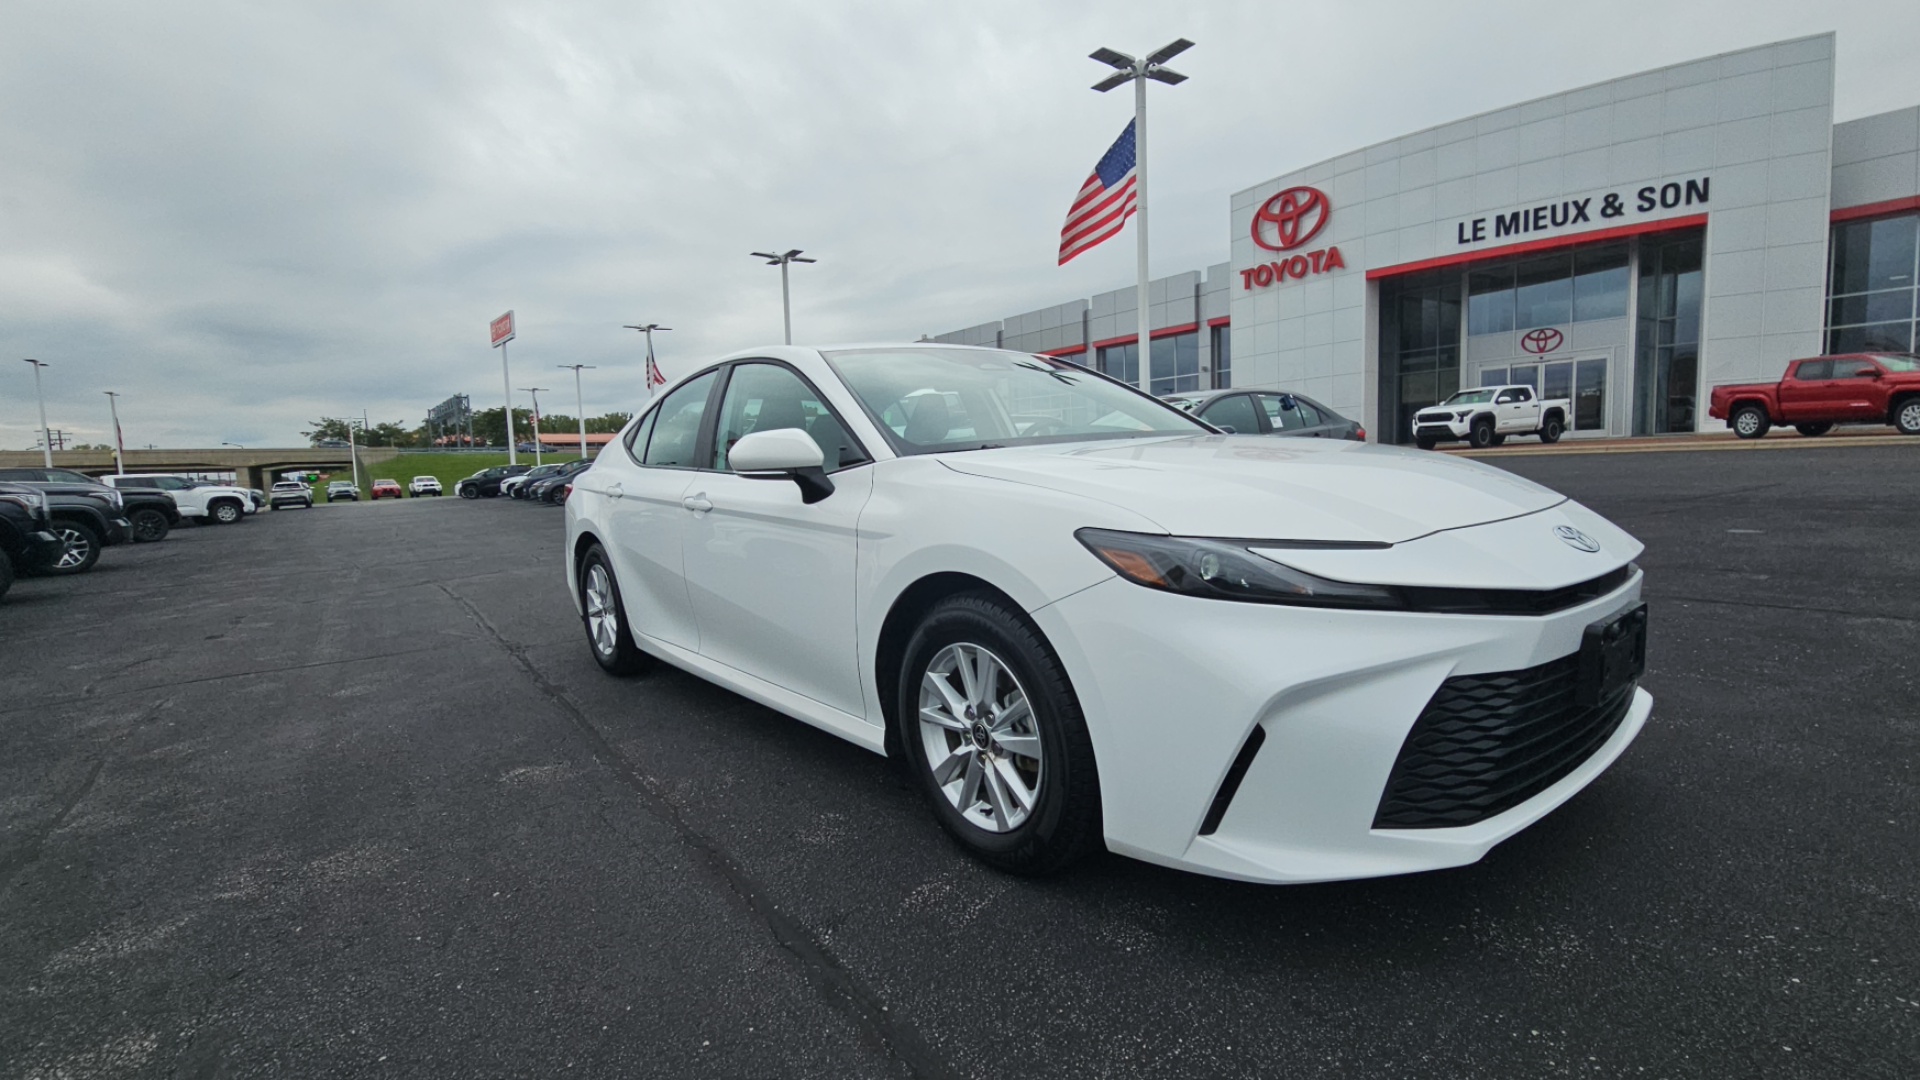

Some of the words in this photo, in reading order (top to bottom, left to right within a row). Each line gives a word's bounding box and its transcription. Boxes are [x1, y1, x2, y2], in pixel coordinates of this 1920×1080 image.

[1458, 218, 1486, 244] LE
[1495, 198, 1591, 238] MIEUX
[1600, 192, 1625, 218] &
[1637, 177, 1710, 213] SON
[1240, 246, 1346, 290] TOYOTA
